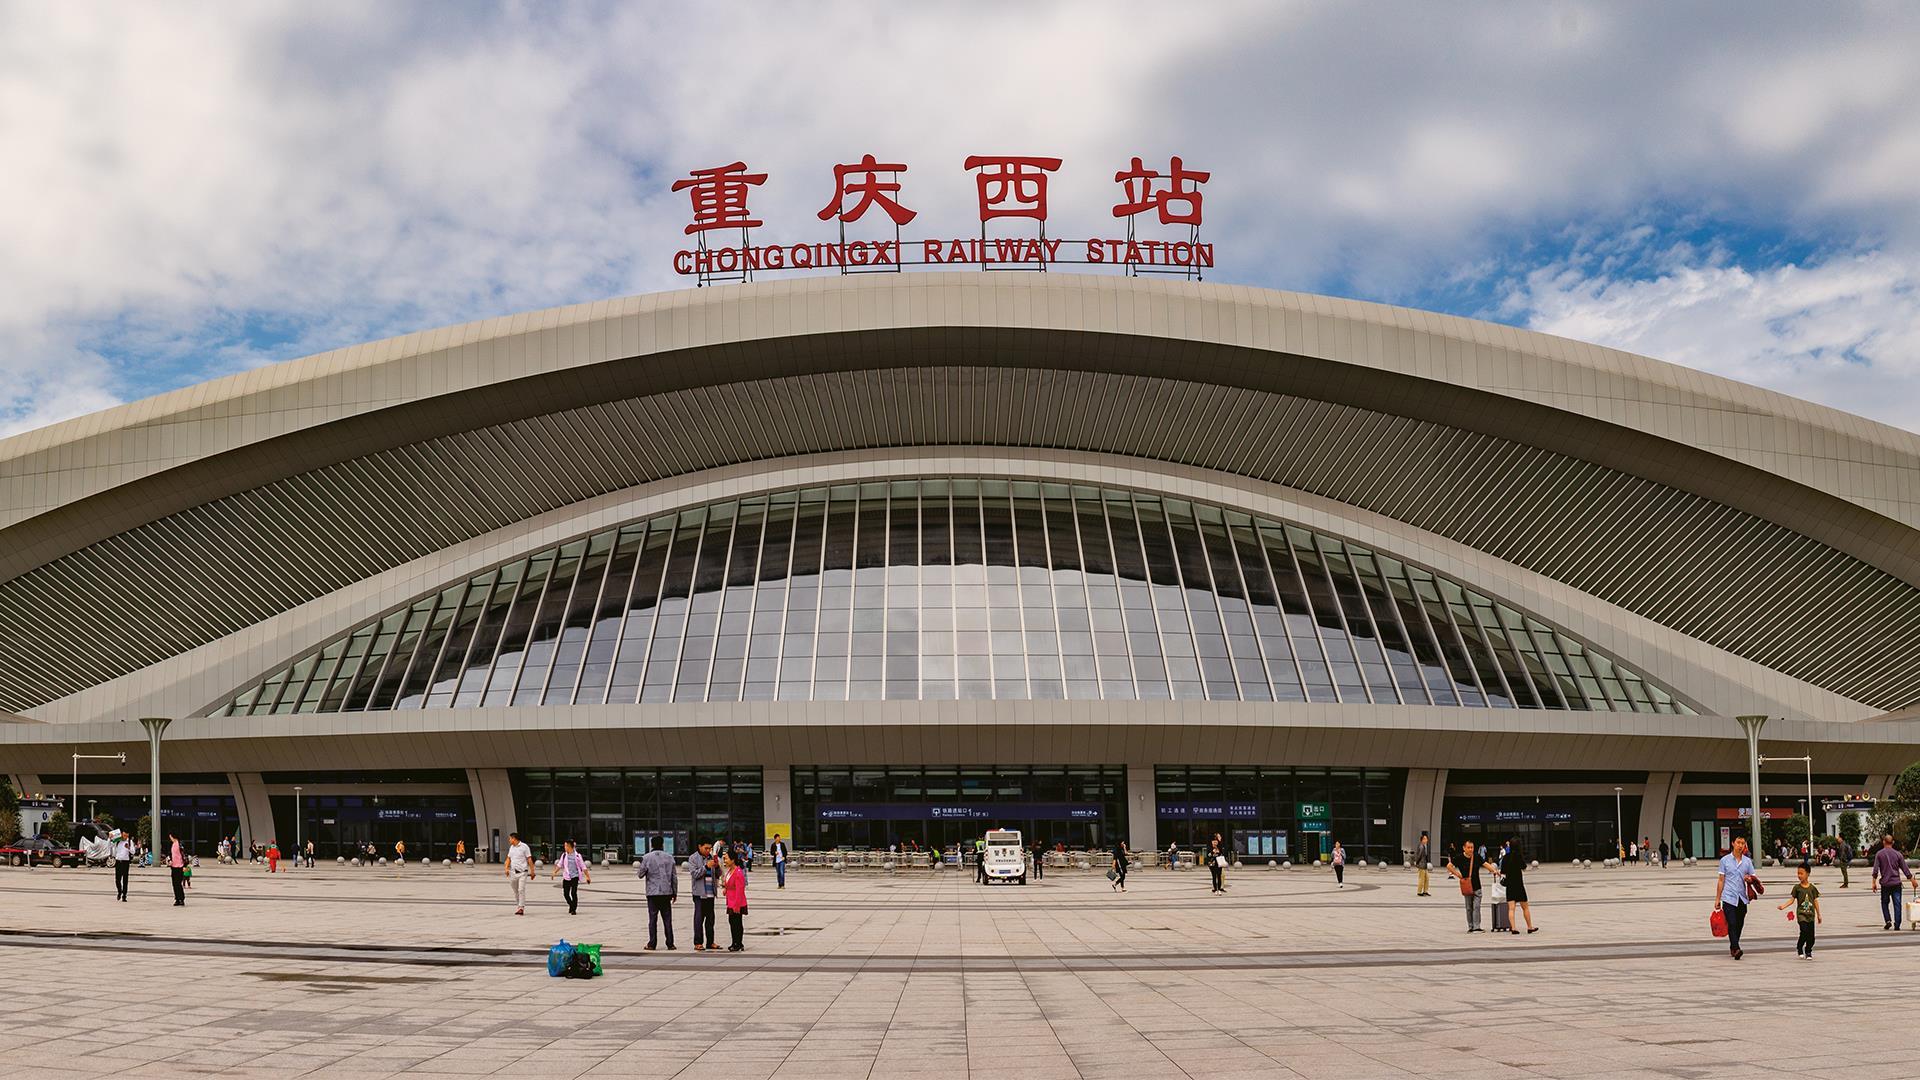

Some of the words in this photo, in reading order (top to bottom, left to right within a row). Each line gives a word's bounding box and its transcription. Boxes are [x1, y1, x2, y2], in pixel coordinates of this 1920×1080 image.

[671, 153, 1211, 235] 重庆西站
[673, 240, 901, 275] CHONGQINGXI
[923, 238, 1063, 265] RAILWAY
[1086, 238, 1214, 268] STATION
